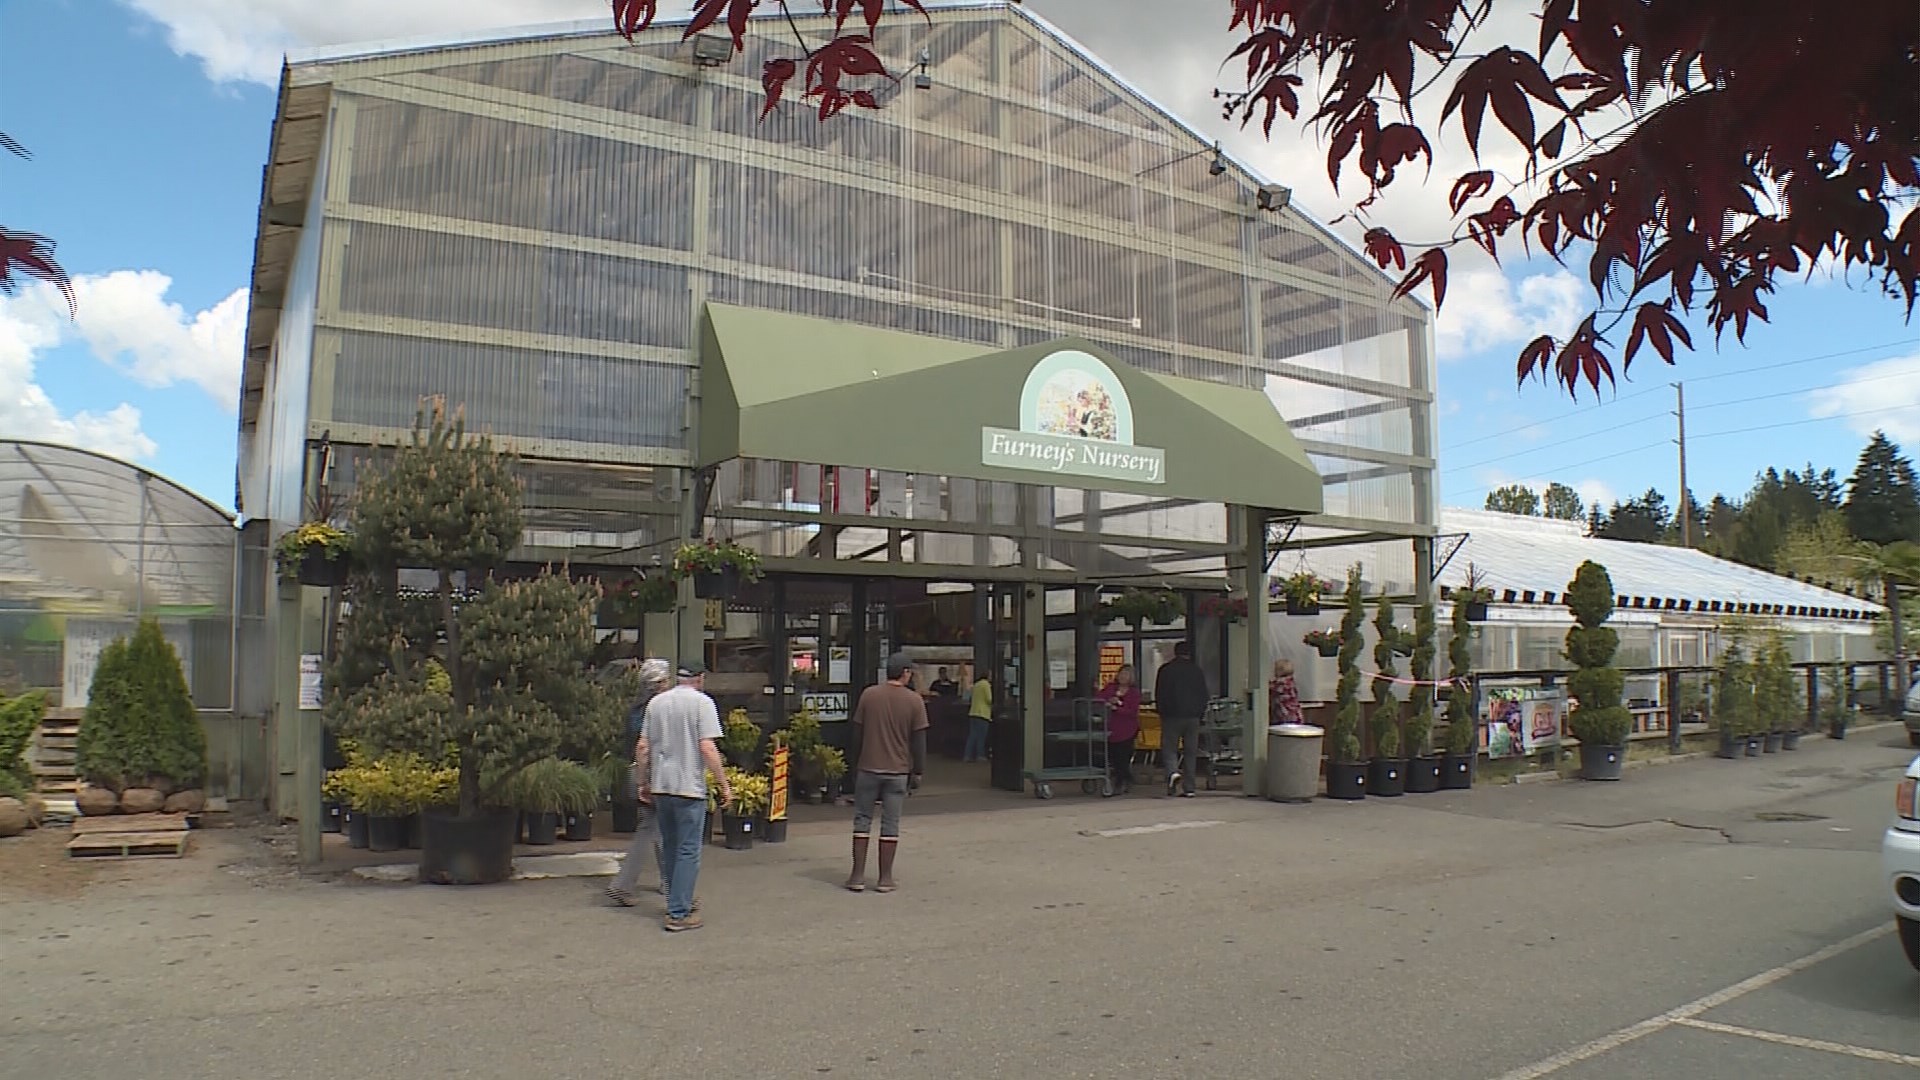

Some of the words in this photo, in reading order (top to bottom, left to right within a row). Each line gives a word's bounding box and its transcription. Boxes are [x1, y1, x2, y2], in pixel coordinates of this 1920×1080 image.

[990, 433, 1075, 470] Furney's
[1082, 445, 1160, 480] Nursery
[804, 696, 846, 714] OPEN
